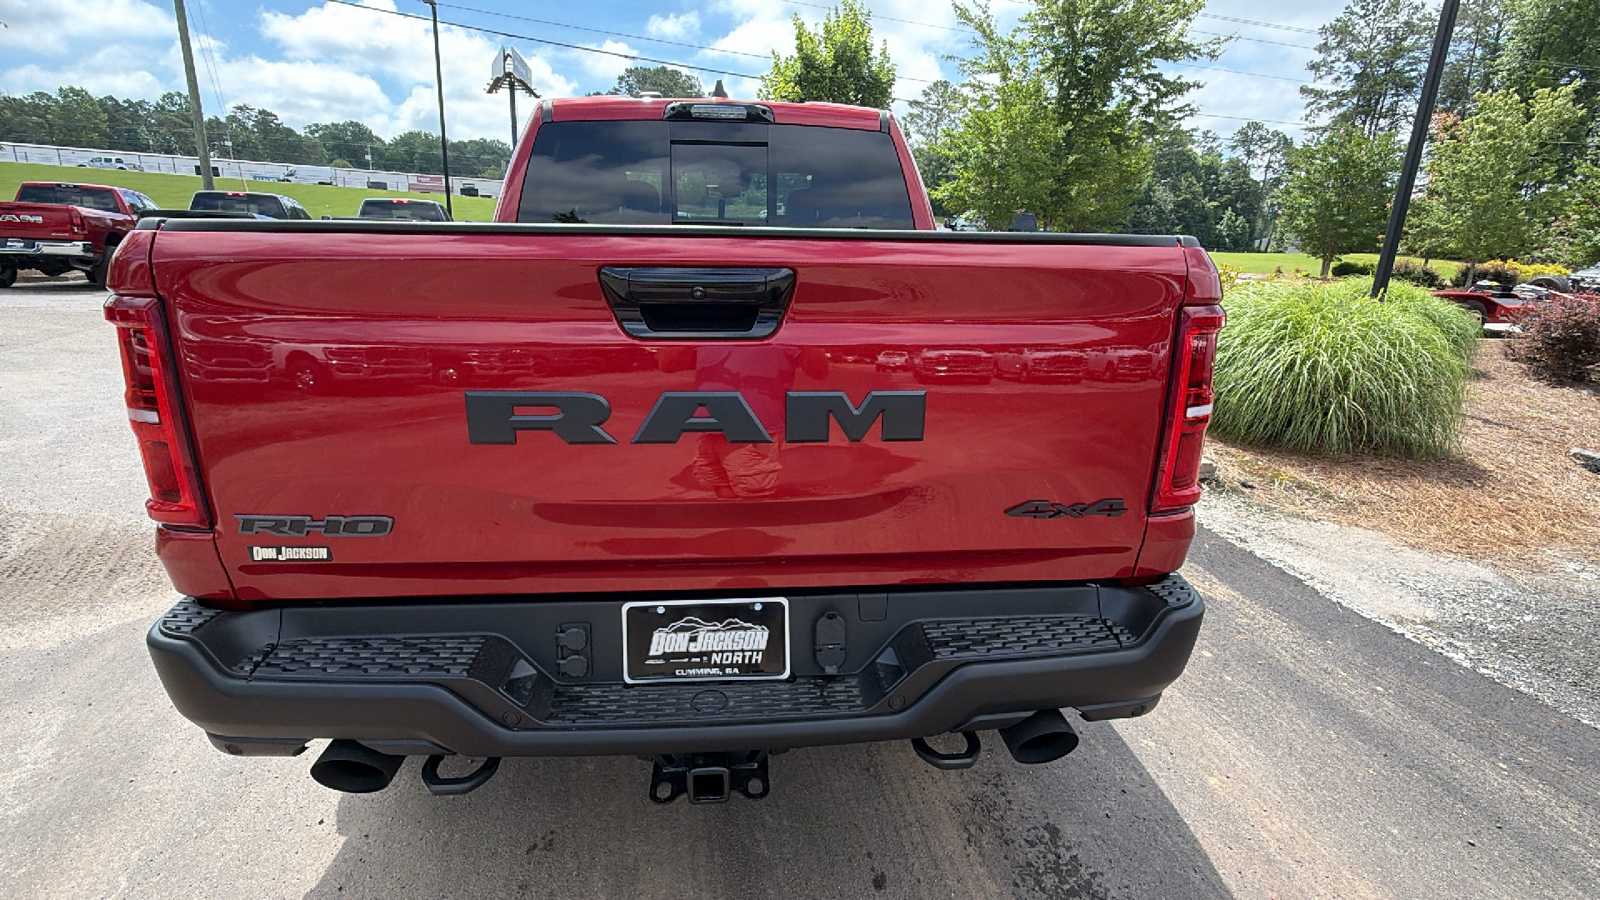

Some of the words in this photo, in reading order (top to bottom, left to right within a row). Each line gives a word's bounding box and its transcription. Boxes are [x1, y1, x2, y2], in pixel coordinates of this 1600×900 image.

[0, 214, 43, 223] AM
[465, 390, 927, 444] RAM
[1003, 498, 1128, 518] 4x4
[233, 514, 394, 537] RHO
[252, 546, 277, 561] DON
[278, 546, 328, 561] JACKSON
[648, 632, 689, 656] DON
[688, 630, 769, 652] JACKSON
[711, 651, 763, 664] NORTH
[675, 668, 723, 676] CUMMING,
